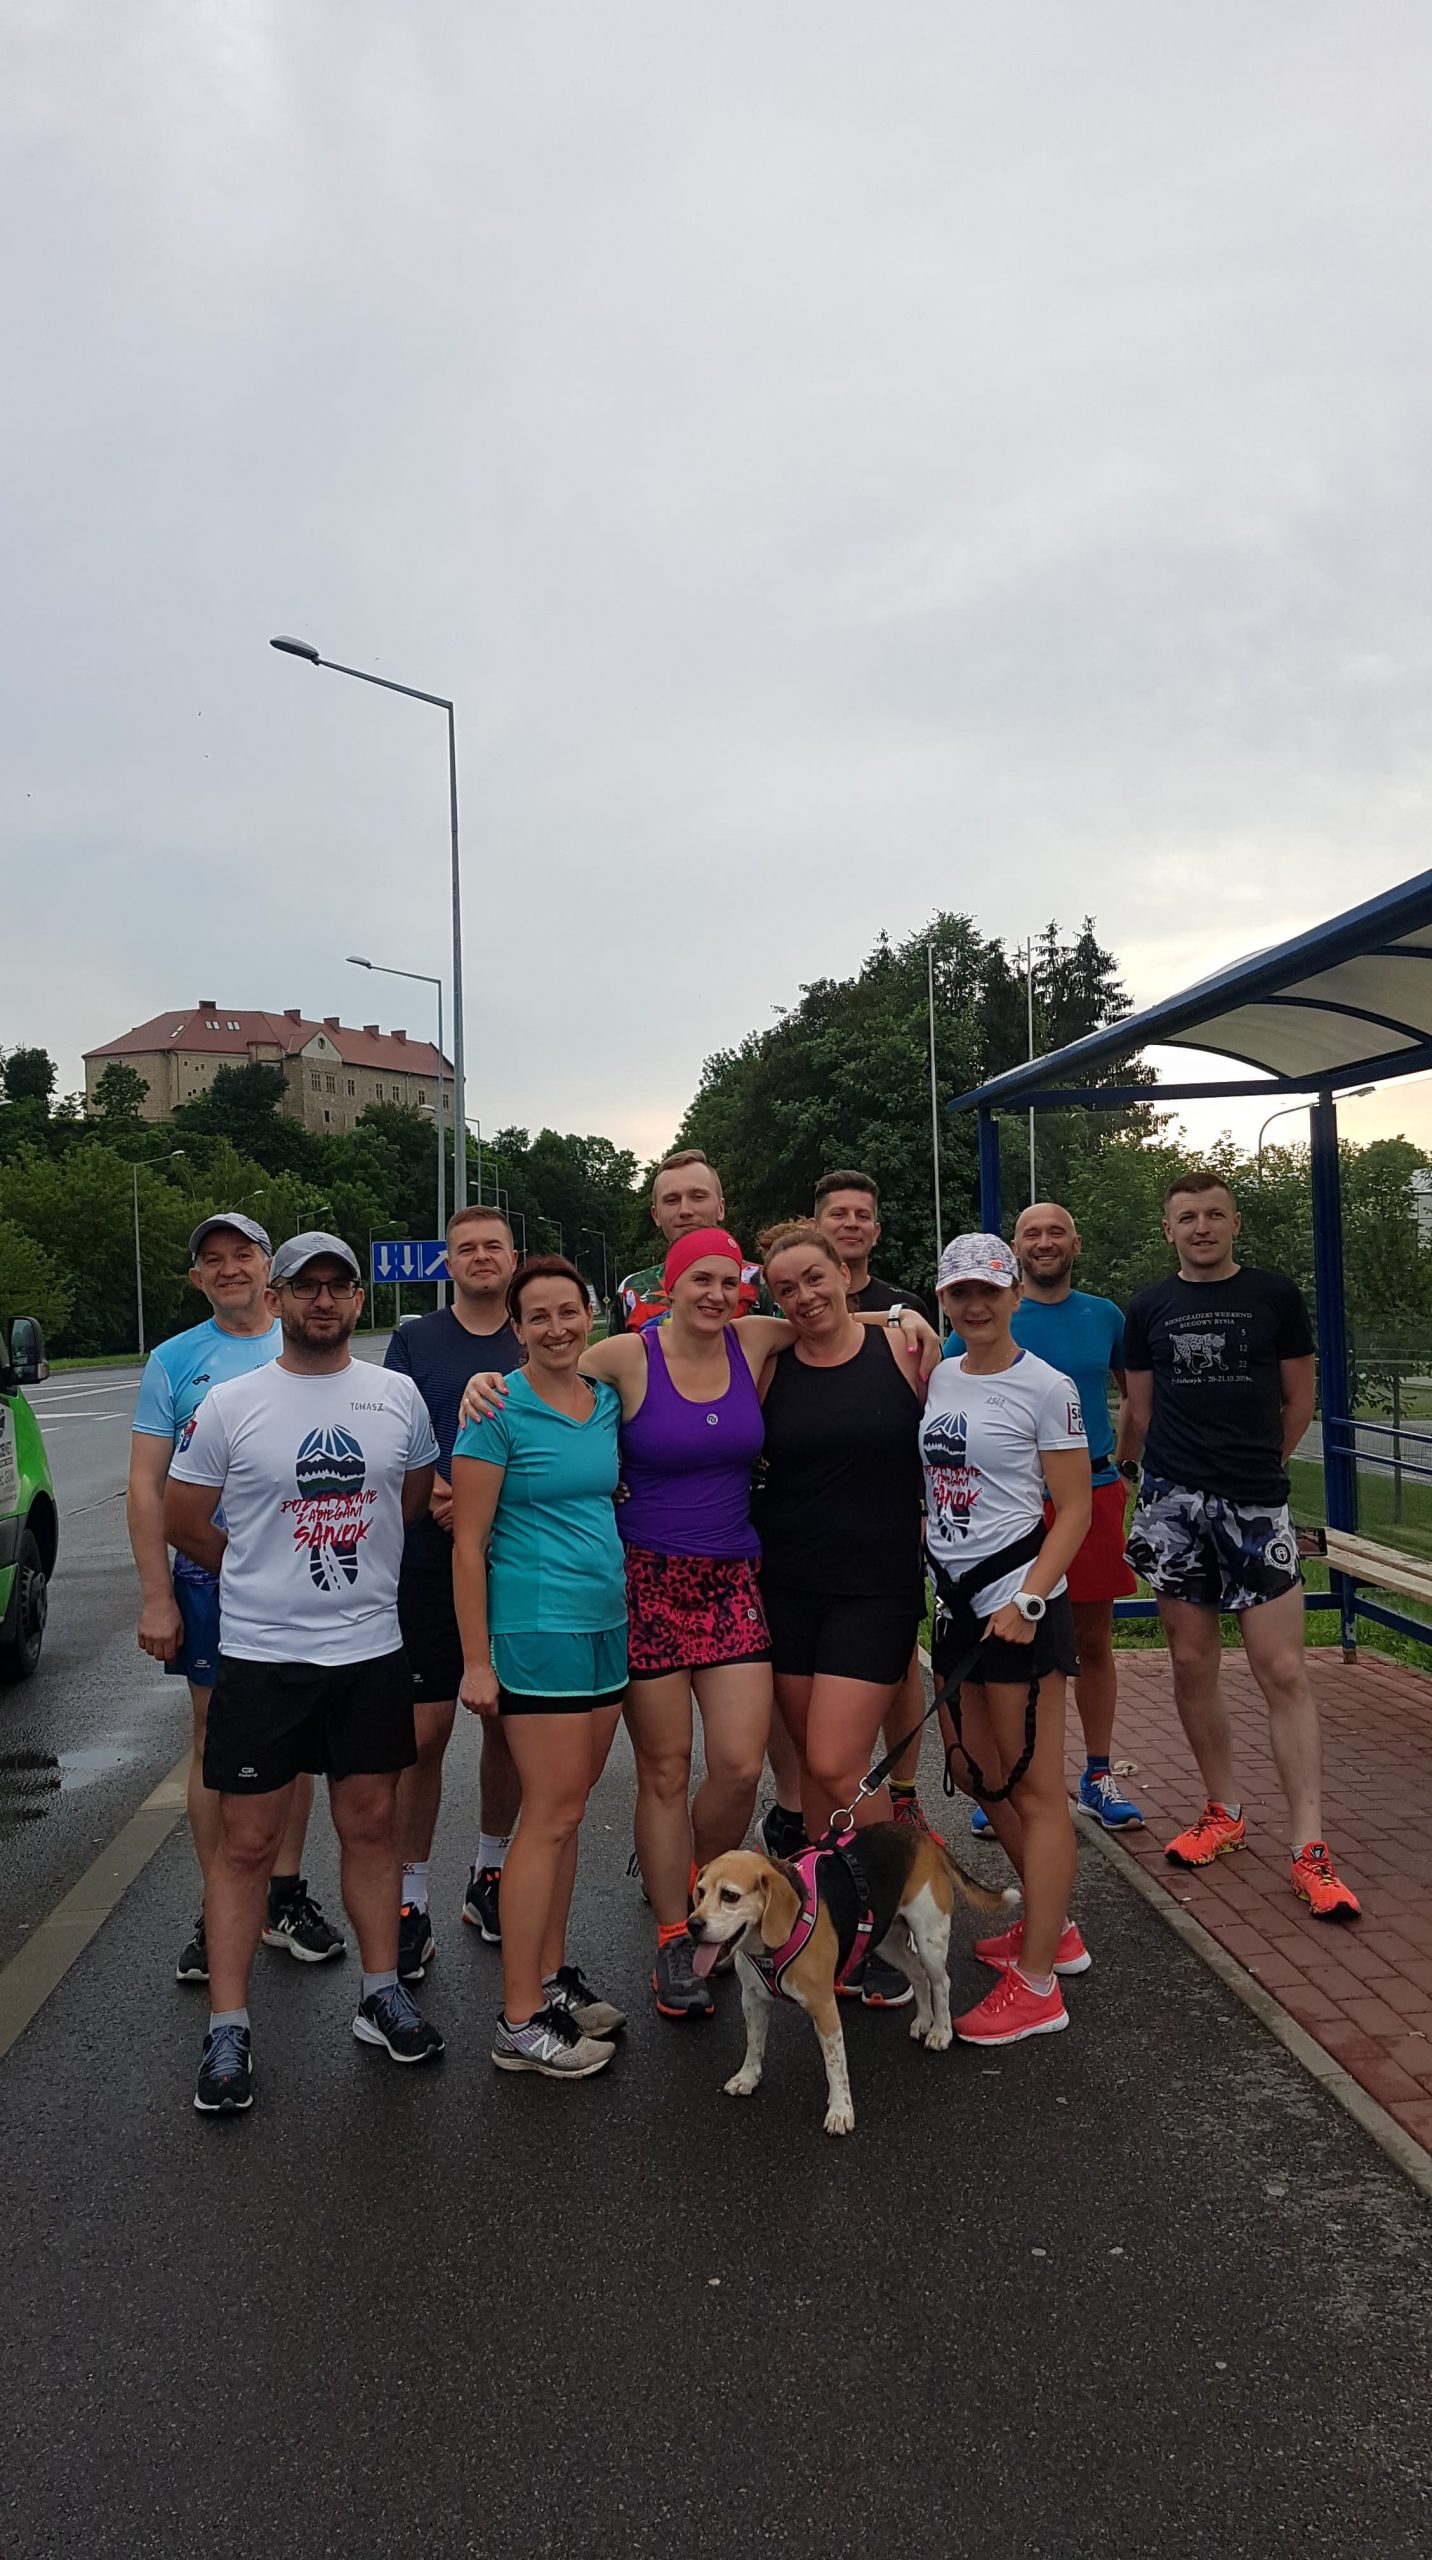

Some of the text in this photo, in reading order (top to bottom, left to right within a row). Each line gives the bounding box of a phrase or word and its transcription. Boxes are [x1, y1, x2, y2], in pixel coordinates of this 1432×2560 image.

[1179, 1319, 1213, 1328] BIEGOWY
[1241, 1328, 1246, 1336] 5
[1239, 1344, 1248, 1352] 12
[350, 1401, 384, 1412] TOMASZ
[933, 1484, 982, 1506] SANOK
[293, 1516, 374, 1552] SANOK
